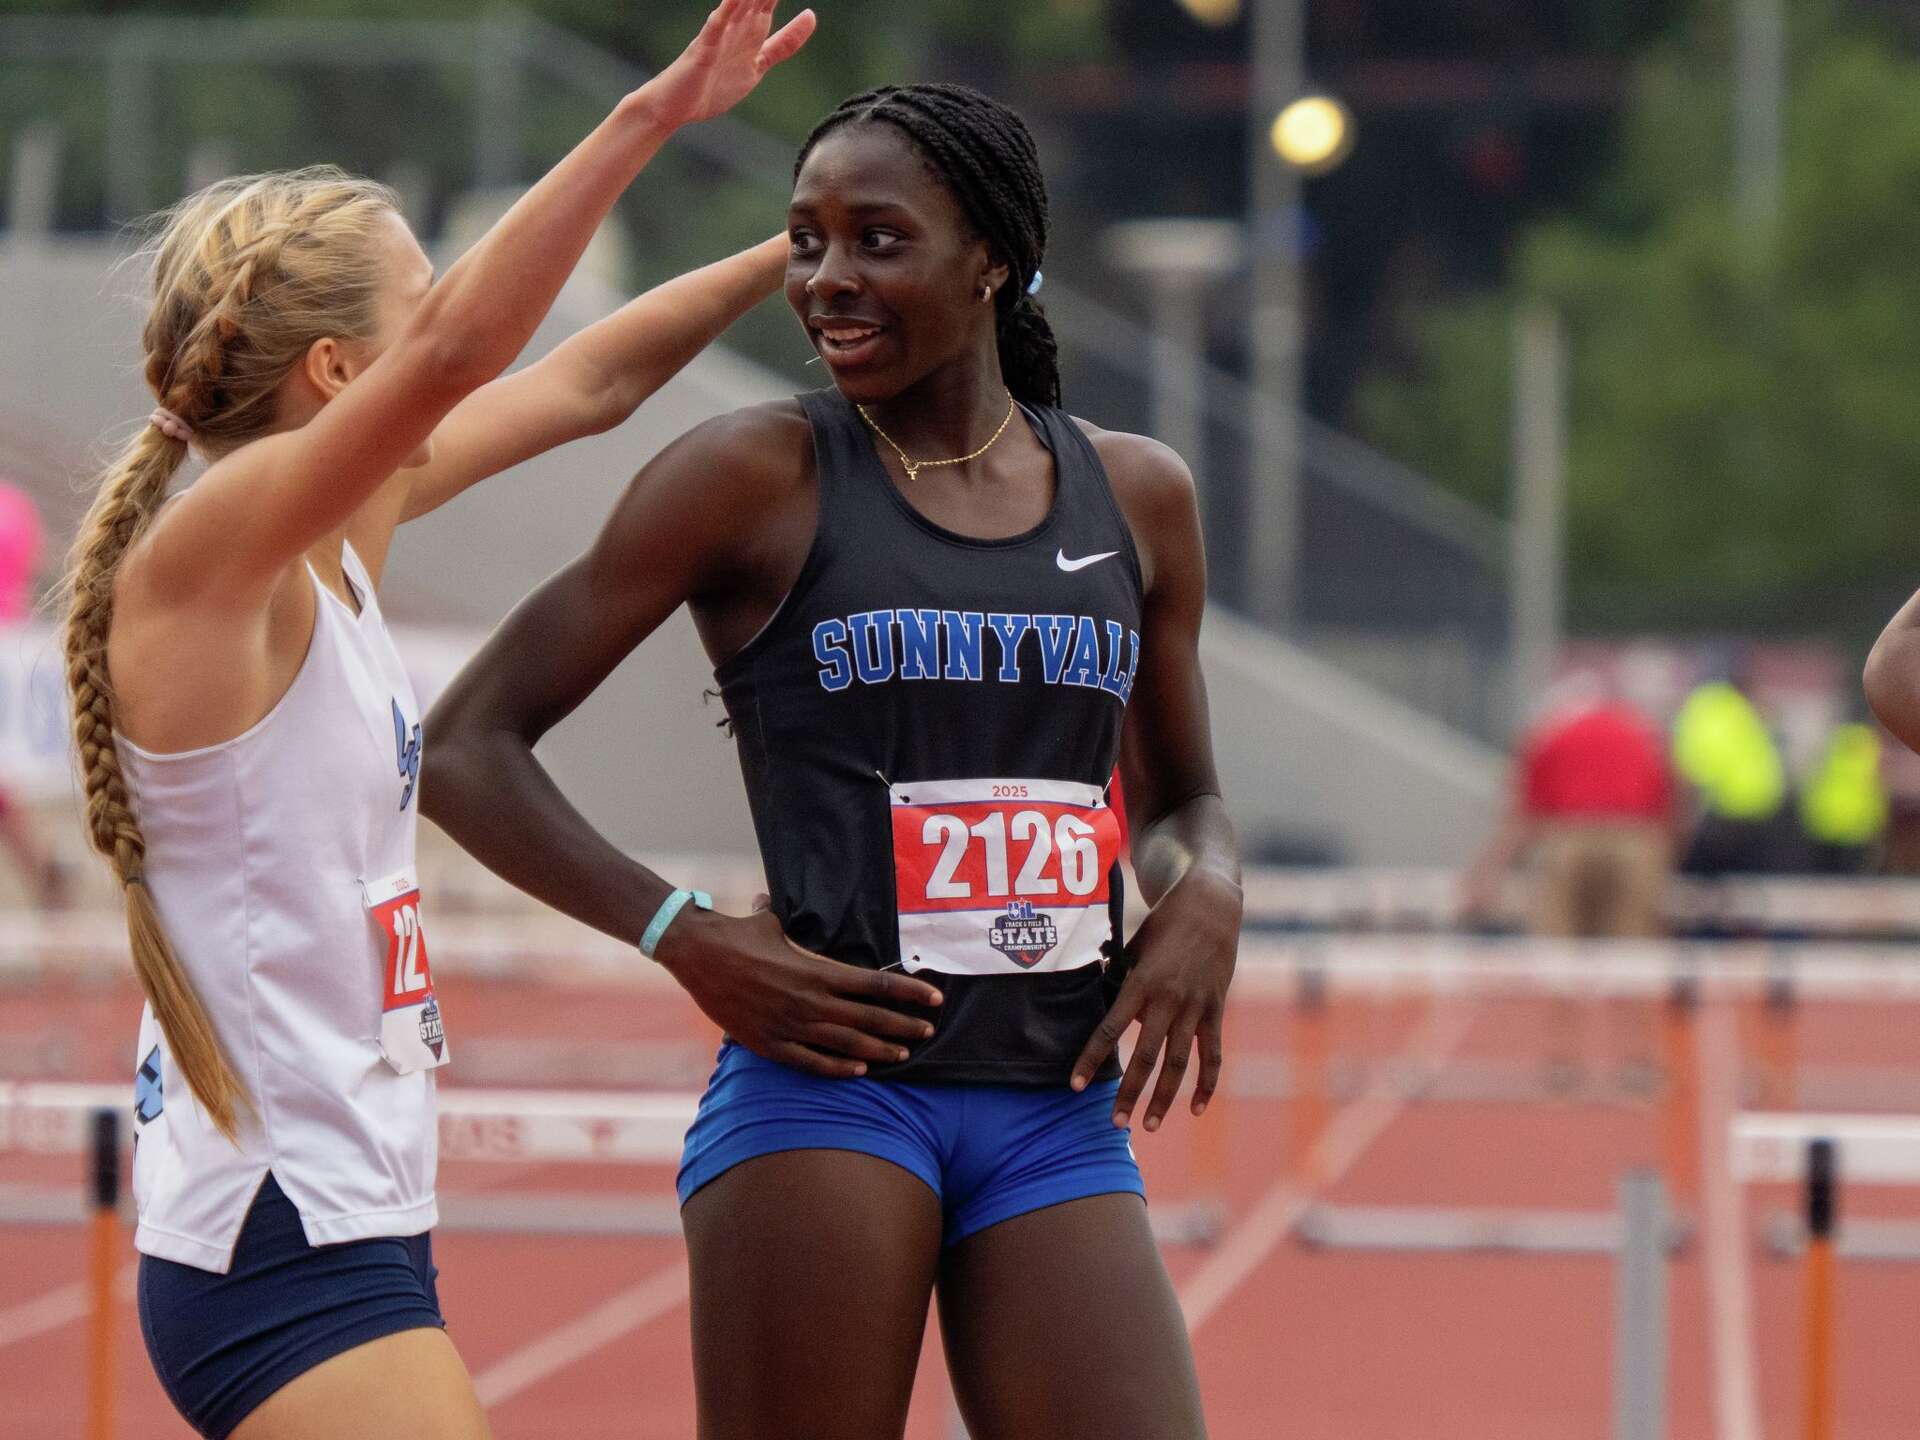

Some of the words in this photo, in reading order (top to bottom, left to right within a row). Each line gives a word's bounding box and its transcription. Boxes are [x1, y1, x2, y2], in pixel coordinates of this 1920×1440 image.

[992, 785, 1028, 797] 2025
[922, 810, 1098, 899] 2126
[990, 927, 1056, 944] STATE
